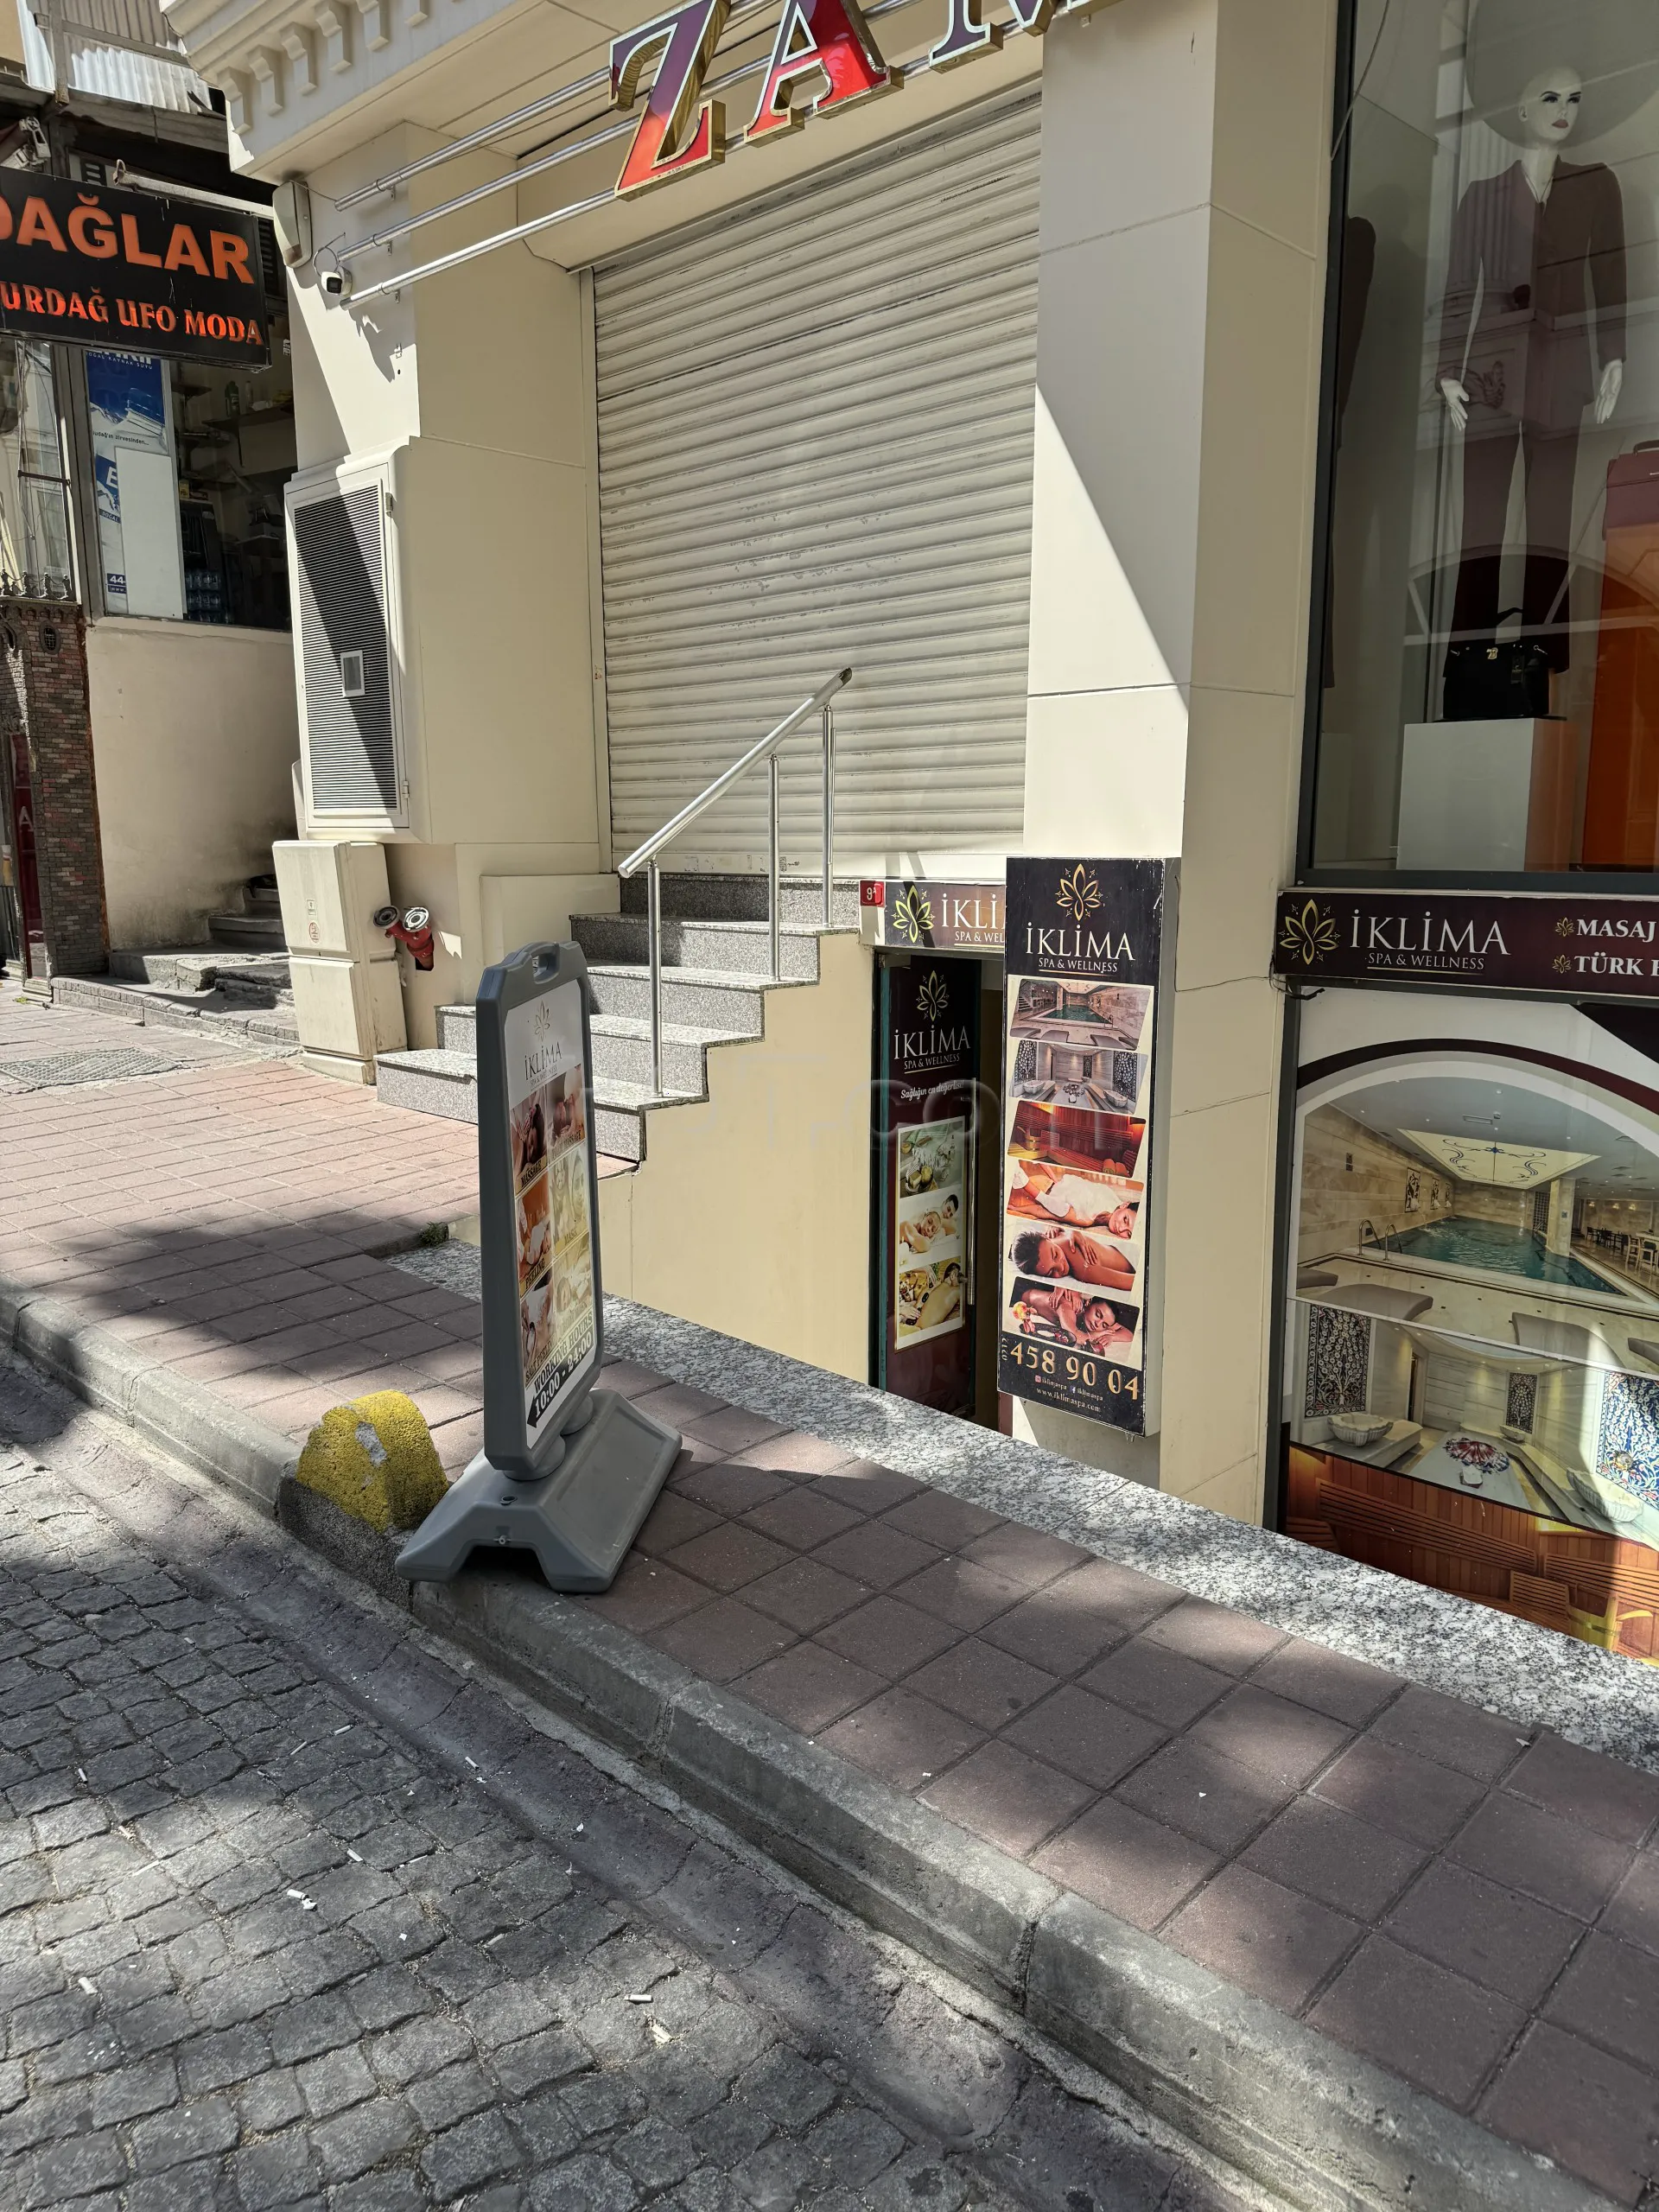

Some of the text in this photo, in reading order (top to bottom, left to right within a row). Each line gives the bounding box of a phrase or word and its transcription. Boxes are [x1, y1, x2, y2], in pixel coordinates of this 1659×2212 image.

[116, 299, 176, 332] UFO
[184, 309, 264, 345] MODA
[941, 893, 1005, 929] İKLİ
[955, 931, 971, 941] SPA
[974, 932, 982, 941] &
[1026, 921, 1135, 961] İKLİMA
[1350, 909, 1510, 956] İKLİMA
[1576, 918, 1657, 943] MASAJ
[1039, 957, 1117, 972] SPA & WELLNESS
[1368, 952, 1484, 969] SPA & WELLNESS
[1574, 951, 1644, 976] TÜRK
[893, 1025, 971, 1059] İKLİMA
[524, 1041, 563, 1080] İKLİMA
[904, 1052, 960, 1070] SPA & WELLNESS
[534, 1343, 568, 1394] WORKING
[568, 1313, 593, 1350] HOURS
[1010, 1342, 1140, 1401] 458 90 04
[535, 1371, 561, 1418] 10:00
[567, 1332, 593, 1370] 24:00
